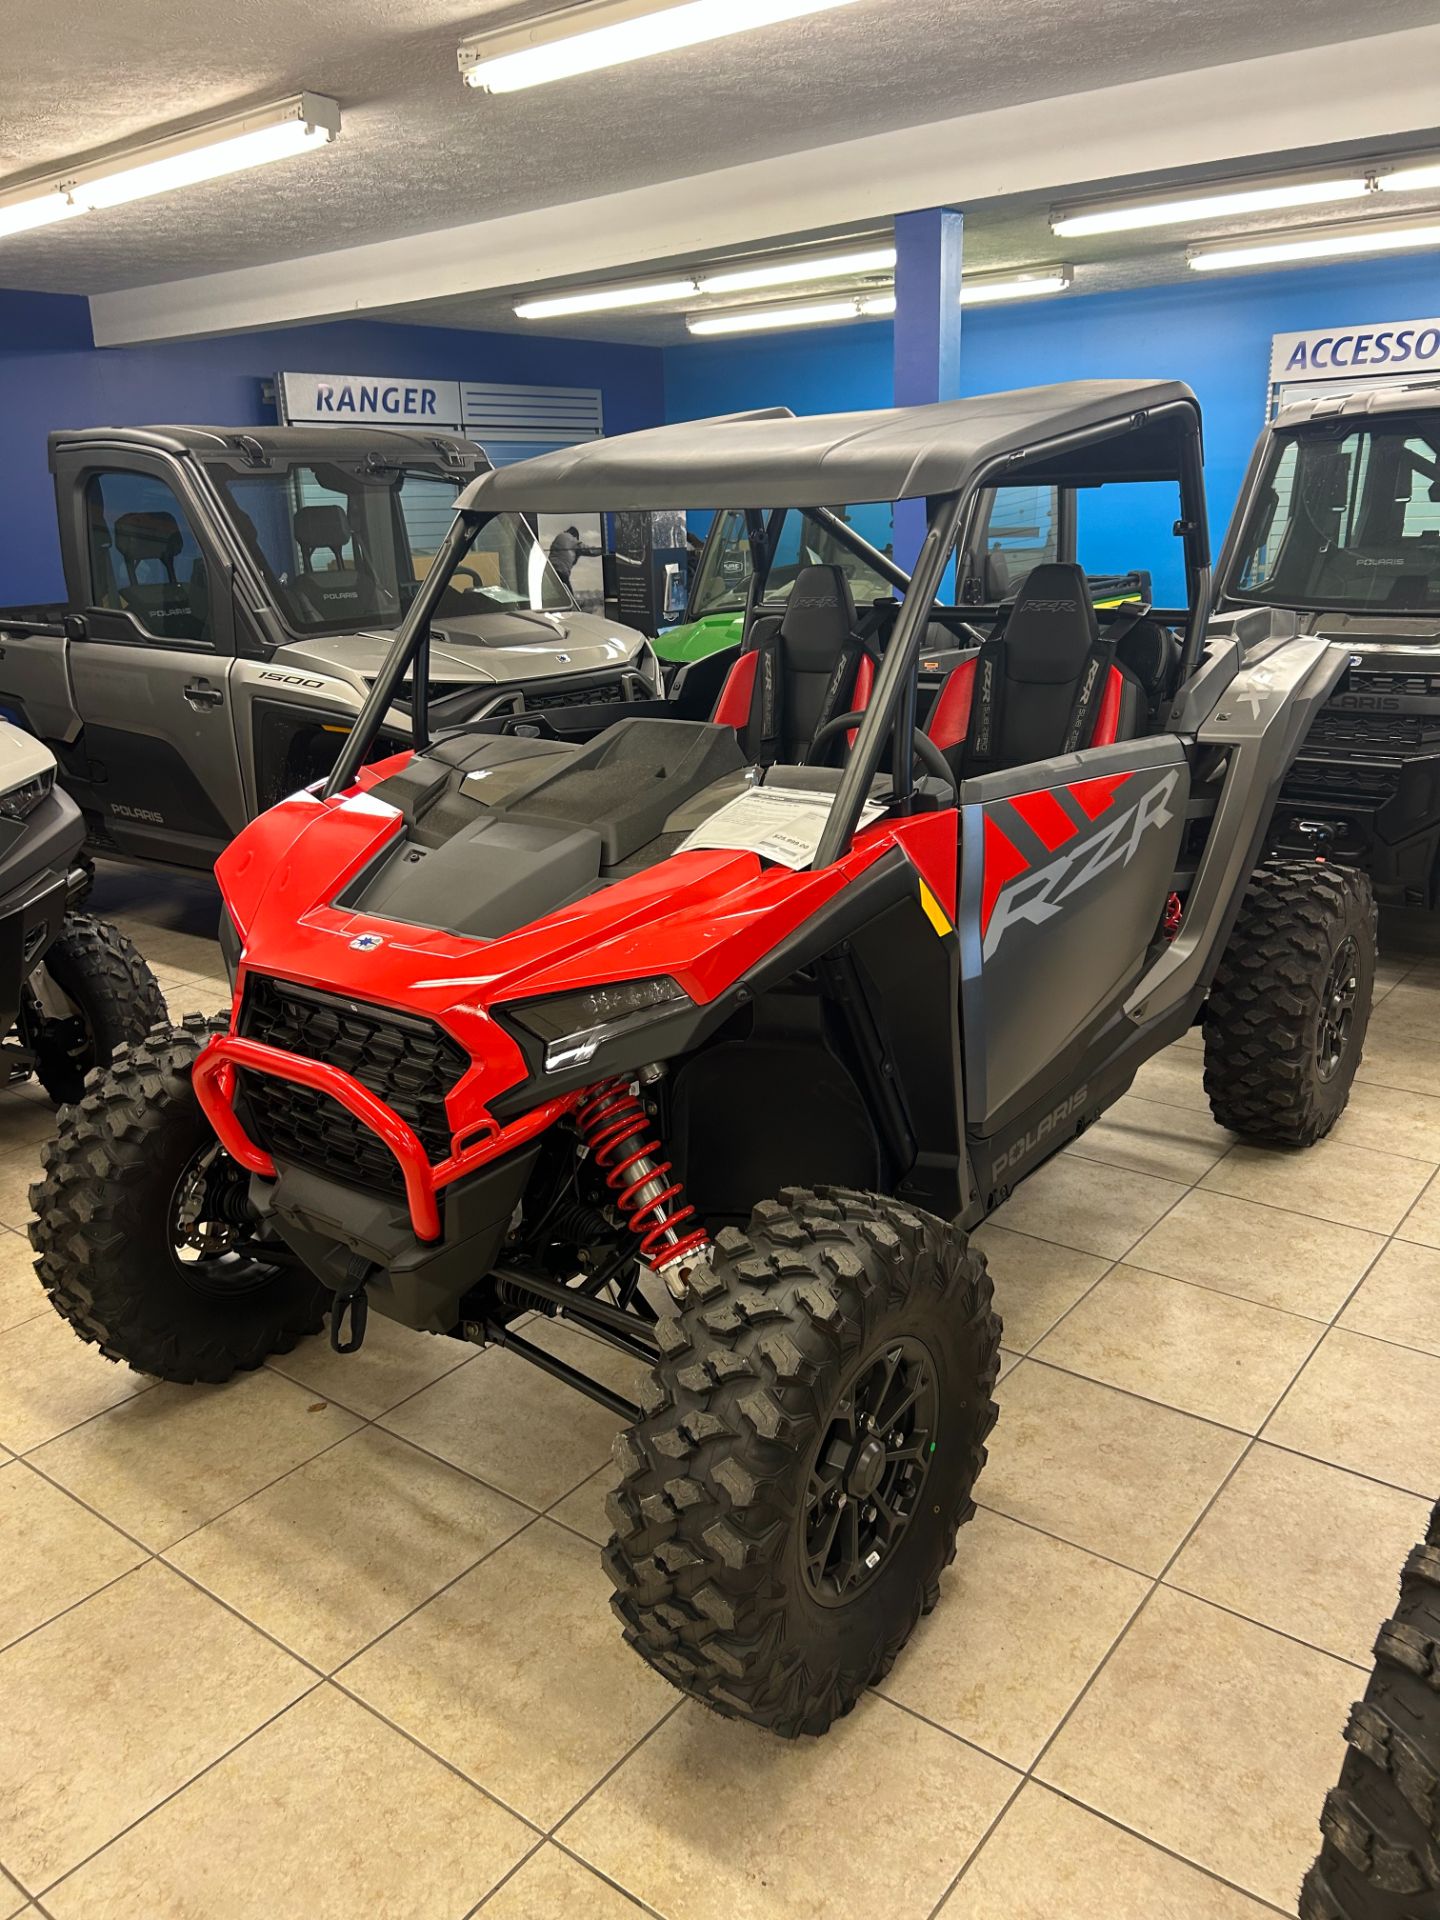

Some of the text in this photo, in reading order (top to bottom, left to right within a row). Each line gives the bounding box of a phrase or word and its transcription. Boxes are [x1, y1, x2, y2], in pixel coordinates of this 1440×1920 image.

[1285, 328, 1440, 371] ACCESSO
[316, 383, 437, 415] RANGER
[1356, 558, 1405, 566] POLARIS
[322, 591, 359, 601] POLARIS
[794, 596, 839, 609] RZR
[1020, 599, 1077, 613] RZR
[148, 607, 193, 618] POLARIS
[258, 671, 325, 689] 1500
[982, 659, 993, 704] RZR
[1079, 658, 1100, 705] RZR
[111, 803, 164, 823] POLARIS
[982, 768, 1180, 965] RZR
[991, 1083, 1089, 1184] POLARIS
